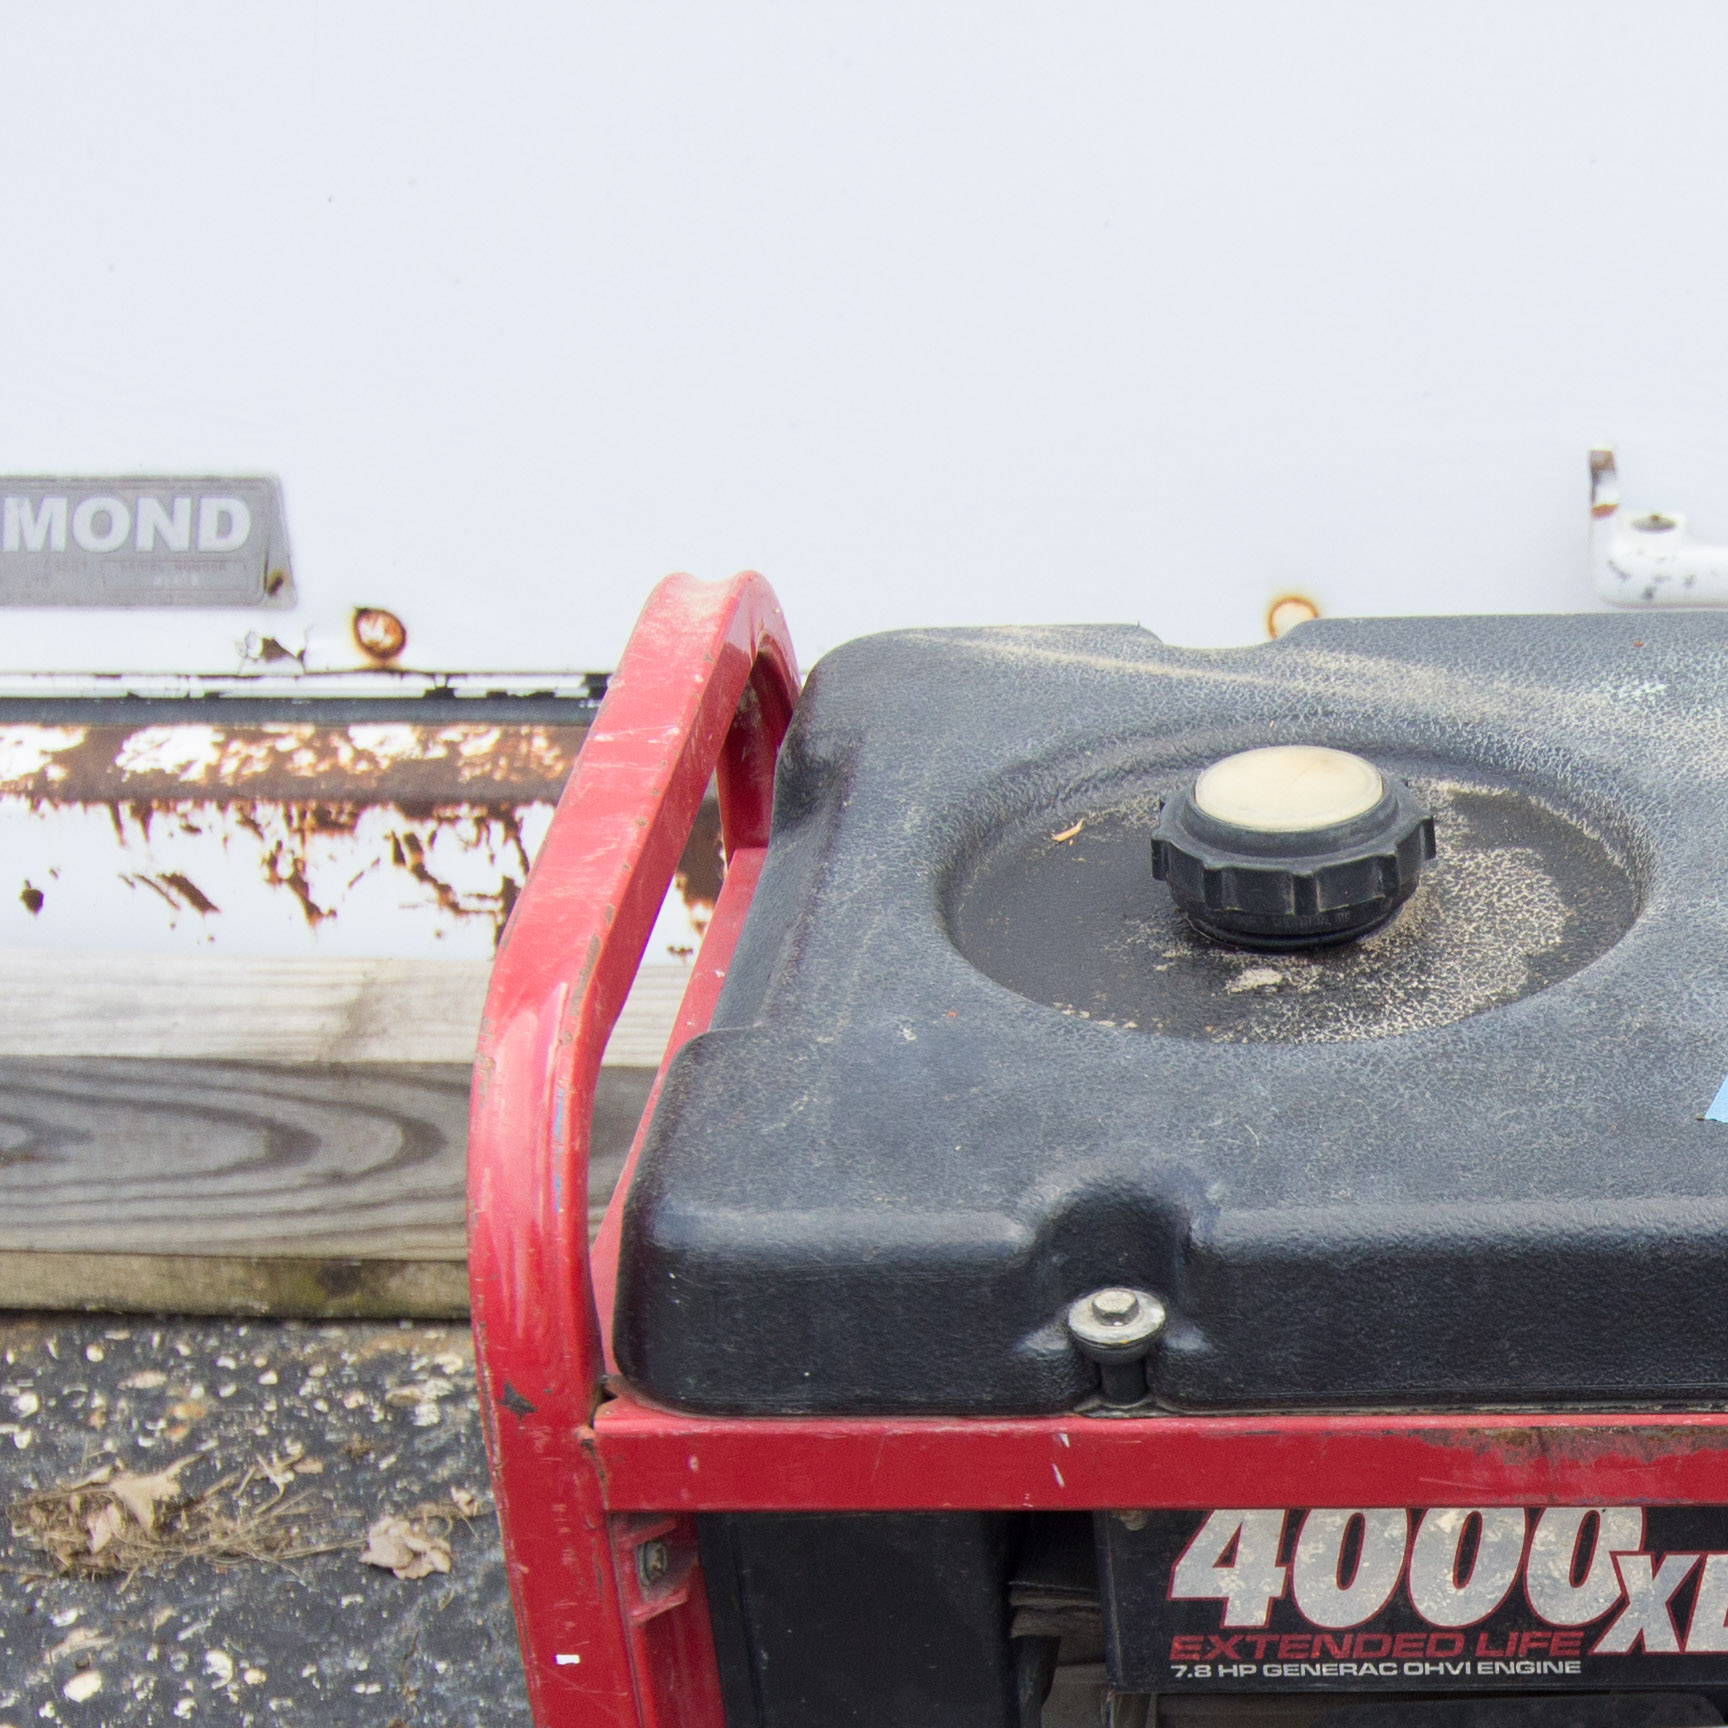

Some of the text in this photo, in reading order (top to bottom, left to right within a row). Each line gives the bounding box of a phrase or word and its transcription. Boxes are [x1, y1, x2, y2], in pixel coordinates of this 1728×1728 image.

[1, 497, 250, 551] MOND
[1169, 1631, 1585, 1661] EXTENDED LIFE
[1170, 1660, 1582, 1678] 7.8 HP GENERAC OHVI ENGINE
